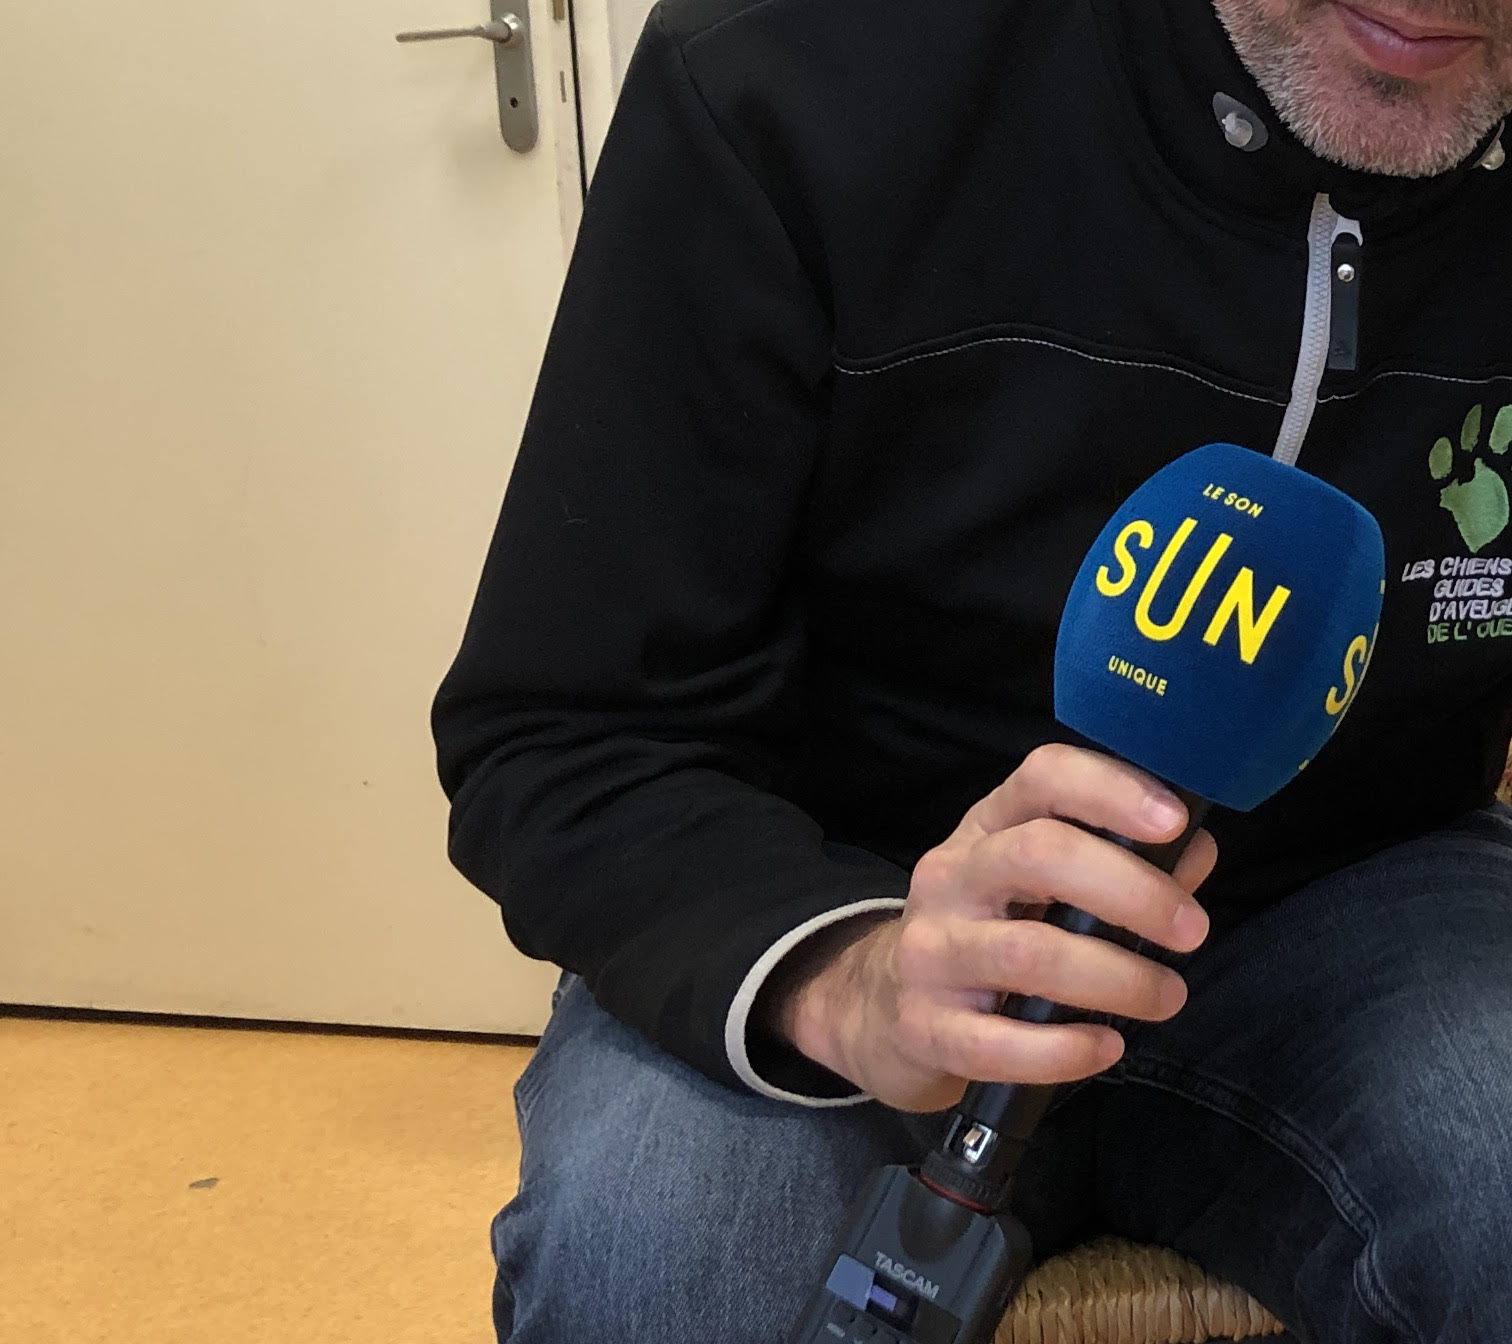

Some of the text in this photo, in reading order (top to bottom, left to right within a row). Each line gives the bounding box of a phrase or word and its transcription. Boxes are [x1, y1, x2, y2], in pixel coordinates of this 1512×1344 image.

[1202, 483, 1264, 519] LE SON
[1401, 556, 1512, 582] LES CHIENS
[1095, 517, 1292, 665] SUN
[1434, 578, 1505, 599] GUIDES
[1427, 621, 1450, 643] DE
[1108, 655, 1168, 697] UNIQUE
[874, 1251, 940, 1299] TASCAM
